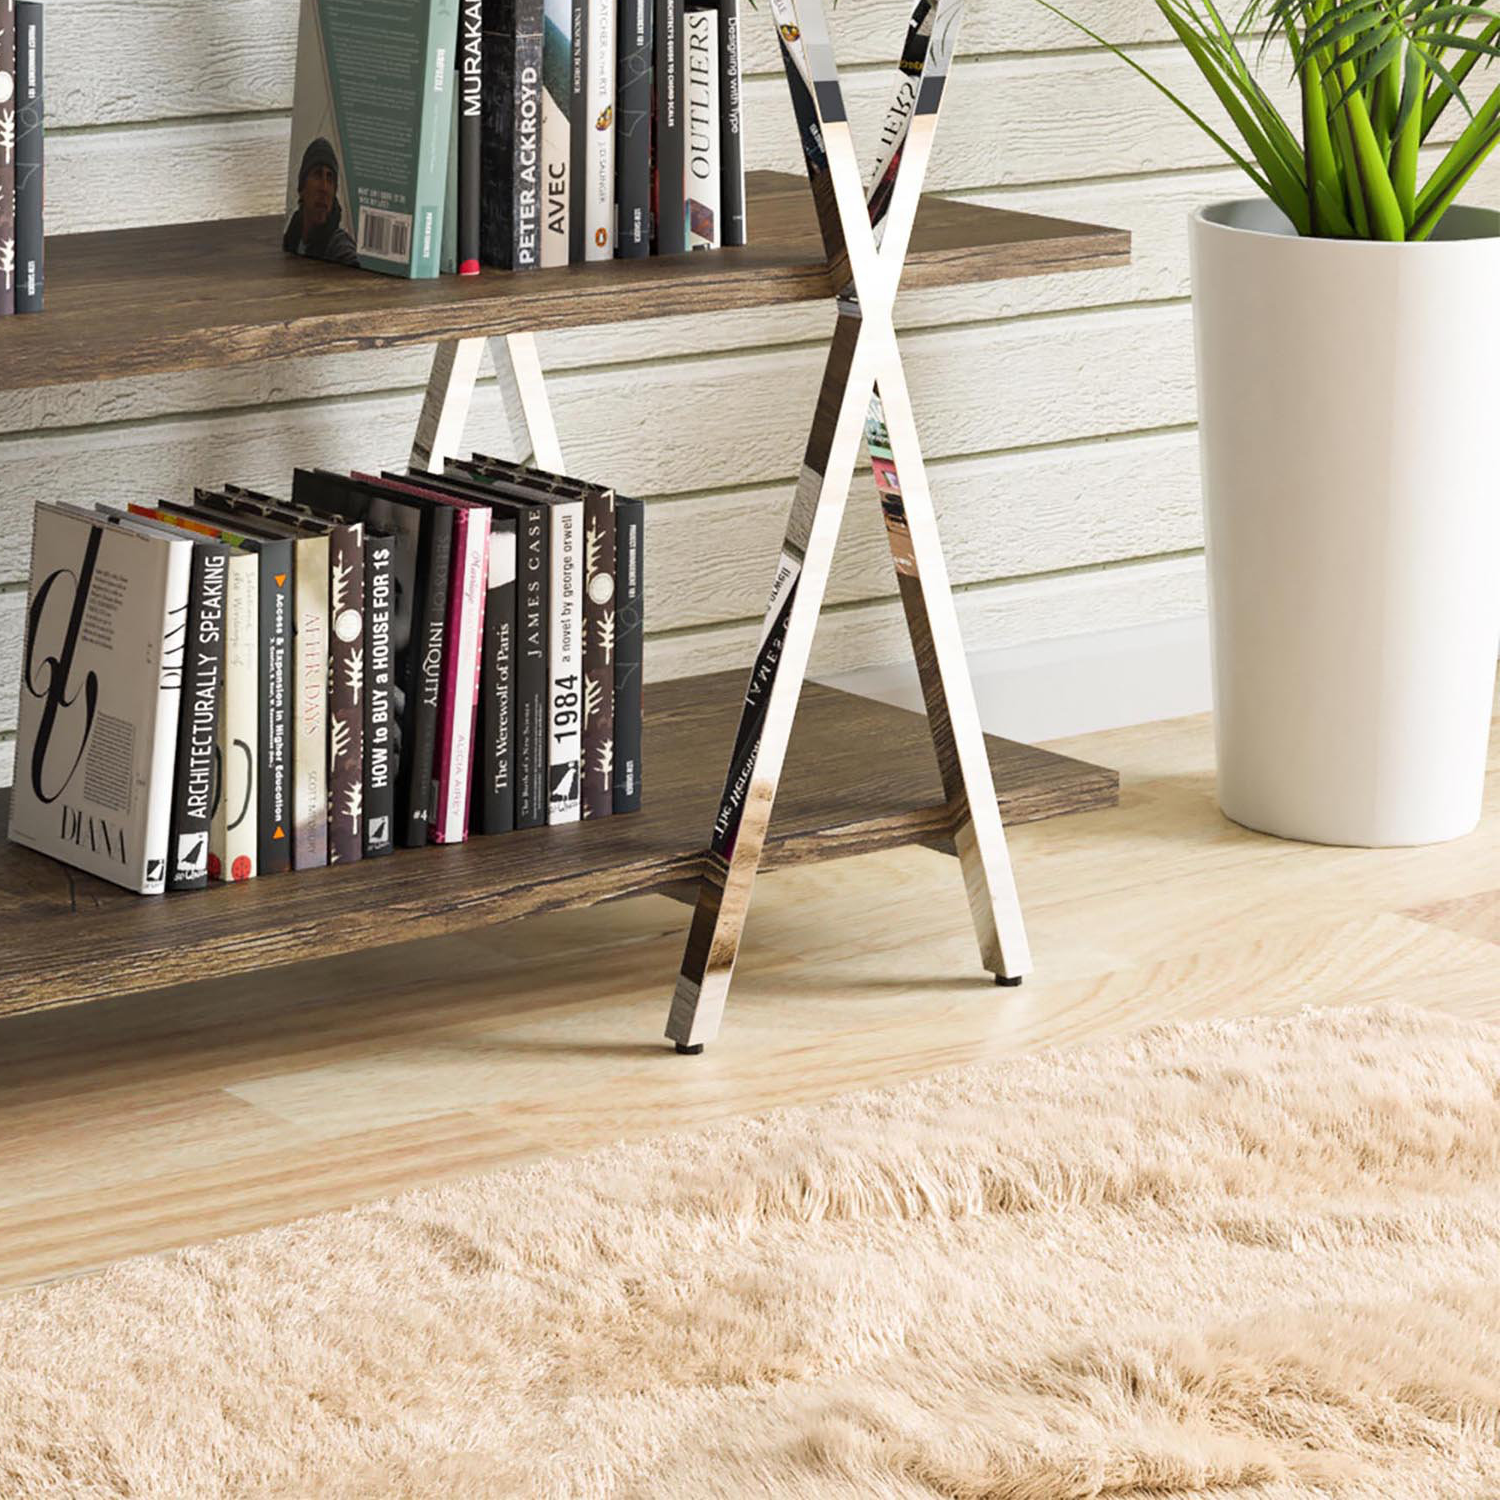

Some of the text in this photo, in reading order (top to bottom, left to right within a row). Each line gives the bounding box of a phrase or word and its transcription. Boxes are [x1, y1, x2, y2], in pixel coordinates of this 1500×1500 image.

[667, 63, 674, 74] TO
[726, 16, 737, 77] Designing
[690, 15, 710, 179] OUTLIERS
[729, 78, 738, 105] with
[519, 66, 538, 264] PETER ACKROYD
[548, 161, 566, 235] AVEC
[562, 515, 573, 552] orwell
[528, 509, 542, 658] JAMES CASE
[562, 556, 574, 599] george
[561, 601, 573, 616] by
[561, 618, 572, 653] novel
[187, 555, 225, 820] ARCHITECTURALLY SPEAKING
[304, 613, 320, 735] AFTER DAYS
[372, 548, 390, 788] HOW to BUY a HOUSE FOR 1$
[422, 621, 444, 707] INIQUITY
[274, 593, 285, 822] Access & Expansion Higher Education
[494, 622, 509, 794] The Werewolf of Paris
[522, 703, 530, 735] Science
[554, 674, 578, 744] 1984
[522, 736, 530, 754] New
[413, 809, 428, 821] #4
[522, 774, 530, 797] Birth
[522, 797, 530, 816] The
[60, 804, 127, 865] DIANA
